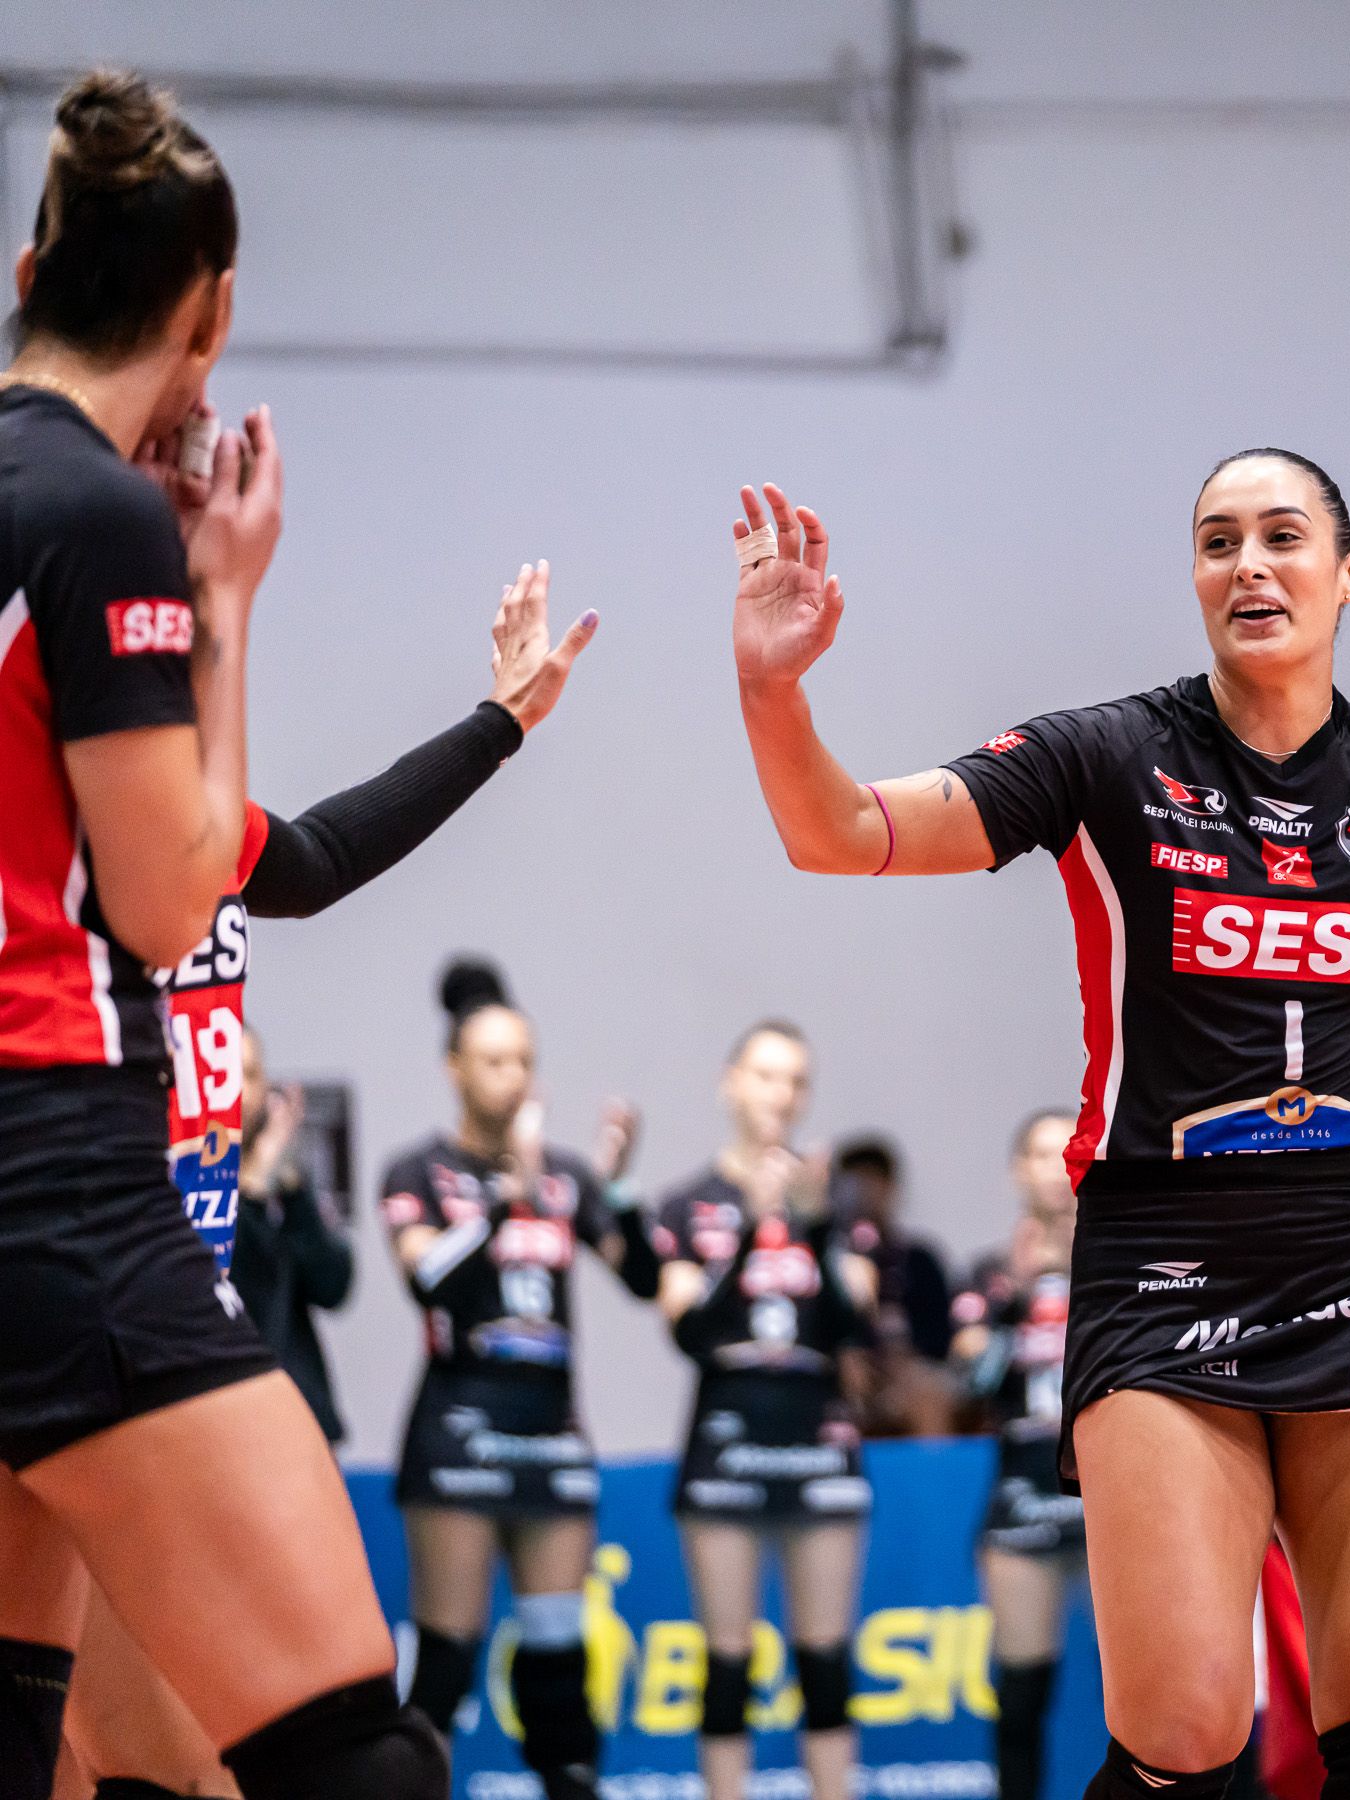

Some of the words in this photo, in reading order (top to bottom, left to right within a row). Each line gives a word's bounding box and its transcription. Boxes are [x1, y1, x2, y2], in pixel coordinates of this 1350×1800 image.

[1143, 804, 1169, 819] SESI
[1200, 820, 1234, 835] BAURU
[1248, 815, 1314, 837] PENALTY
[1157, 847, 1223, 874] FIESP
[153, 904, 251, 988] ESI
[1284, 1000, 1304, 1081] 1
[171, 1006, 243, 1119] 19
[1277, 1096, 1306, 1117] M
[1252, 1129, 1292, 1140] desde
[1301, 1128, 1331, 1139] 1946
[1138, 1276, 1208, 1293] PENALTY
